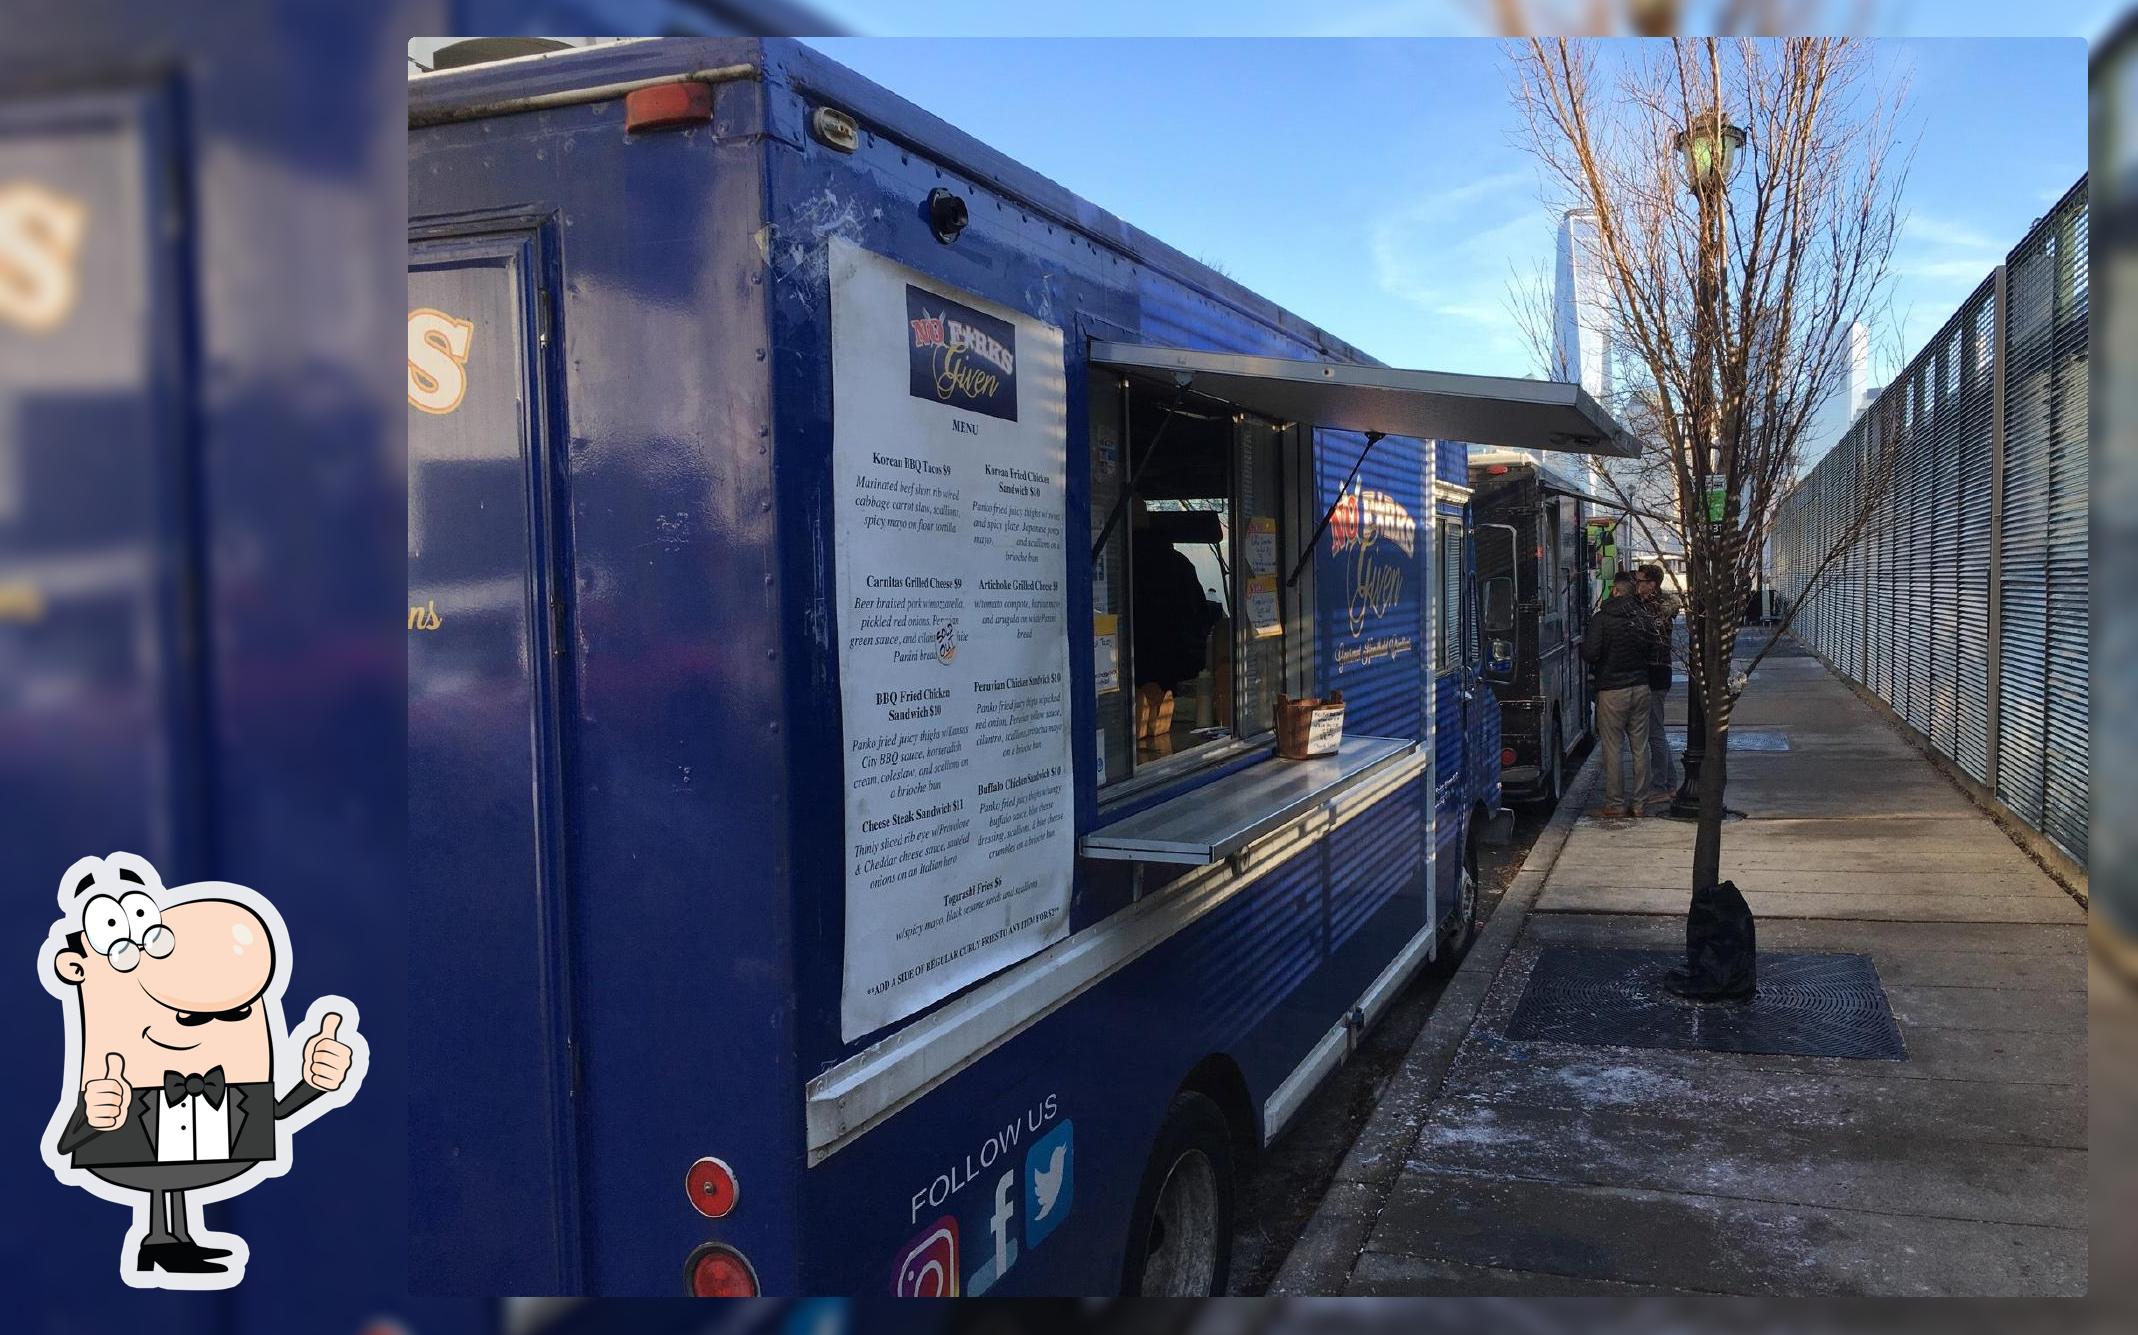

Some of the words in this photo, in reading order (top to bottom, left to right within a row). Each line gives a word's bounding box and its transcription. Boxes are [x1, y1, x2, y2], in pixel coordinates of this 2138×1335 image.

[910, 317, 945, 348] NO
[932, 344, 1000, 400] Given
[952, 419, 979, 436] MENU
[873, 452, 903, 468] Korean
[904, 457, 922, 474] BBQ
[985, 464, 1009, 478] Korean
[1010, 468, 1027, 481] Fried
[856, 475, 899, 492] Marinated
[998, 482, 1029, 496] Sandwich
[855, 495, 890, 511] cabbage
[892, 500, 914, 512] carrot
[864, 514, 886, 530] spicy
[887, 518, 907, 531] mayo
[973, 518, 986, 528] and
[866, 575, 903, 588] Carnitas
[905, 576, 929, 589] Grilled
[930, 577, 953, 589] Cheese
[954, 578, 962, 589] $9
[979, 578, 1012, 591] Artichoke
[1012, 579, 1034, 591] Grilled
[854, 597, 875, 609] Beer
[876, 597, 905, 609] braised
[907, 598, 922, 612] pork
[860, 615, 893, 631] pickled
[894, 614, 907, 627] red
[849, 637, 874, 650] green
[902, 632, 917, 644] and
[1016, 628, 1033, 639] bread
[893, 649, 918, 663] Panini
[974, 679, 1006, 693] Peruvian
[1006, 677, 1029, 689] Chicken
[876, 691, 898, 706] BBQ
[900, 689, 923, 703] Fried
[923, 687, 950, 701] Chicken
[888, 706, 929, 722] Sandwich
[929, 704, 942, 717] $10
[977, 702, 998, 714] Panko
[975, 718, 987, 729] red
[852, 737, 876, 752] Panko
[877, 733, 898, 750] fried
[899, 734, 919, 748] juicy
[920, 728, 941, 743] thighs
[861, 755, 879, 769] City
[880, 751, 899, 766] BBQ
[919, 762, 933, 777] and
[897, 782, 927, 798] brioche
[928, 779, 941, 792] bun
[978, 782, 1004, 796] Buffalo
[1005, 776, 1028, 790] Chicken
[862, 818, 890, 833] Cheese
[892, 810, 915, 826] Steak
[916, 803, 951, 821] Sandwich
[952, 799, 964, 812] $11
[855, 840, 879, 857] Thinly
[880, 835, 903, 851] sliced
[904, 830, 916, 845] rib
[917, 830, 929, 843] eye
[854, 864, 861, 876] &
[864, 855, 898, 873] Cheddar
[899, 849, 923, 864] cheese
[870, 873, 896, 889] onions
[897, 870, 907, 882] on
[908, 866, 918, 878] an
[943, 854, 958, 867] hero
[977, 879, 994, 896] Fries
[896, 923, 923, 941] w/spicy
[946, 908, 963, 922] black
[890, 976, 897, 988] A
[897, 966, 915, 985] SIDE
[915, 963, 925, 977] OF
[926, 950, 959, 973] REGULAR
[959, 937, 982, 959] CURLY
[982, 929, 1000, 948] FRIES
[1000, 926, 1009, 940] TO
[1009, 920, 1021, 936] ANY
[1021, 916, 1036, 932] ITEM
[1036, 911, 1048, 925] FOR
[912, 1118, 1021, 1225] FOLLOW
[1028, 1093, 1057, 1132] US
